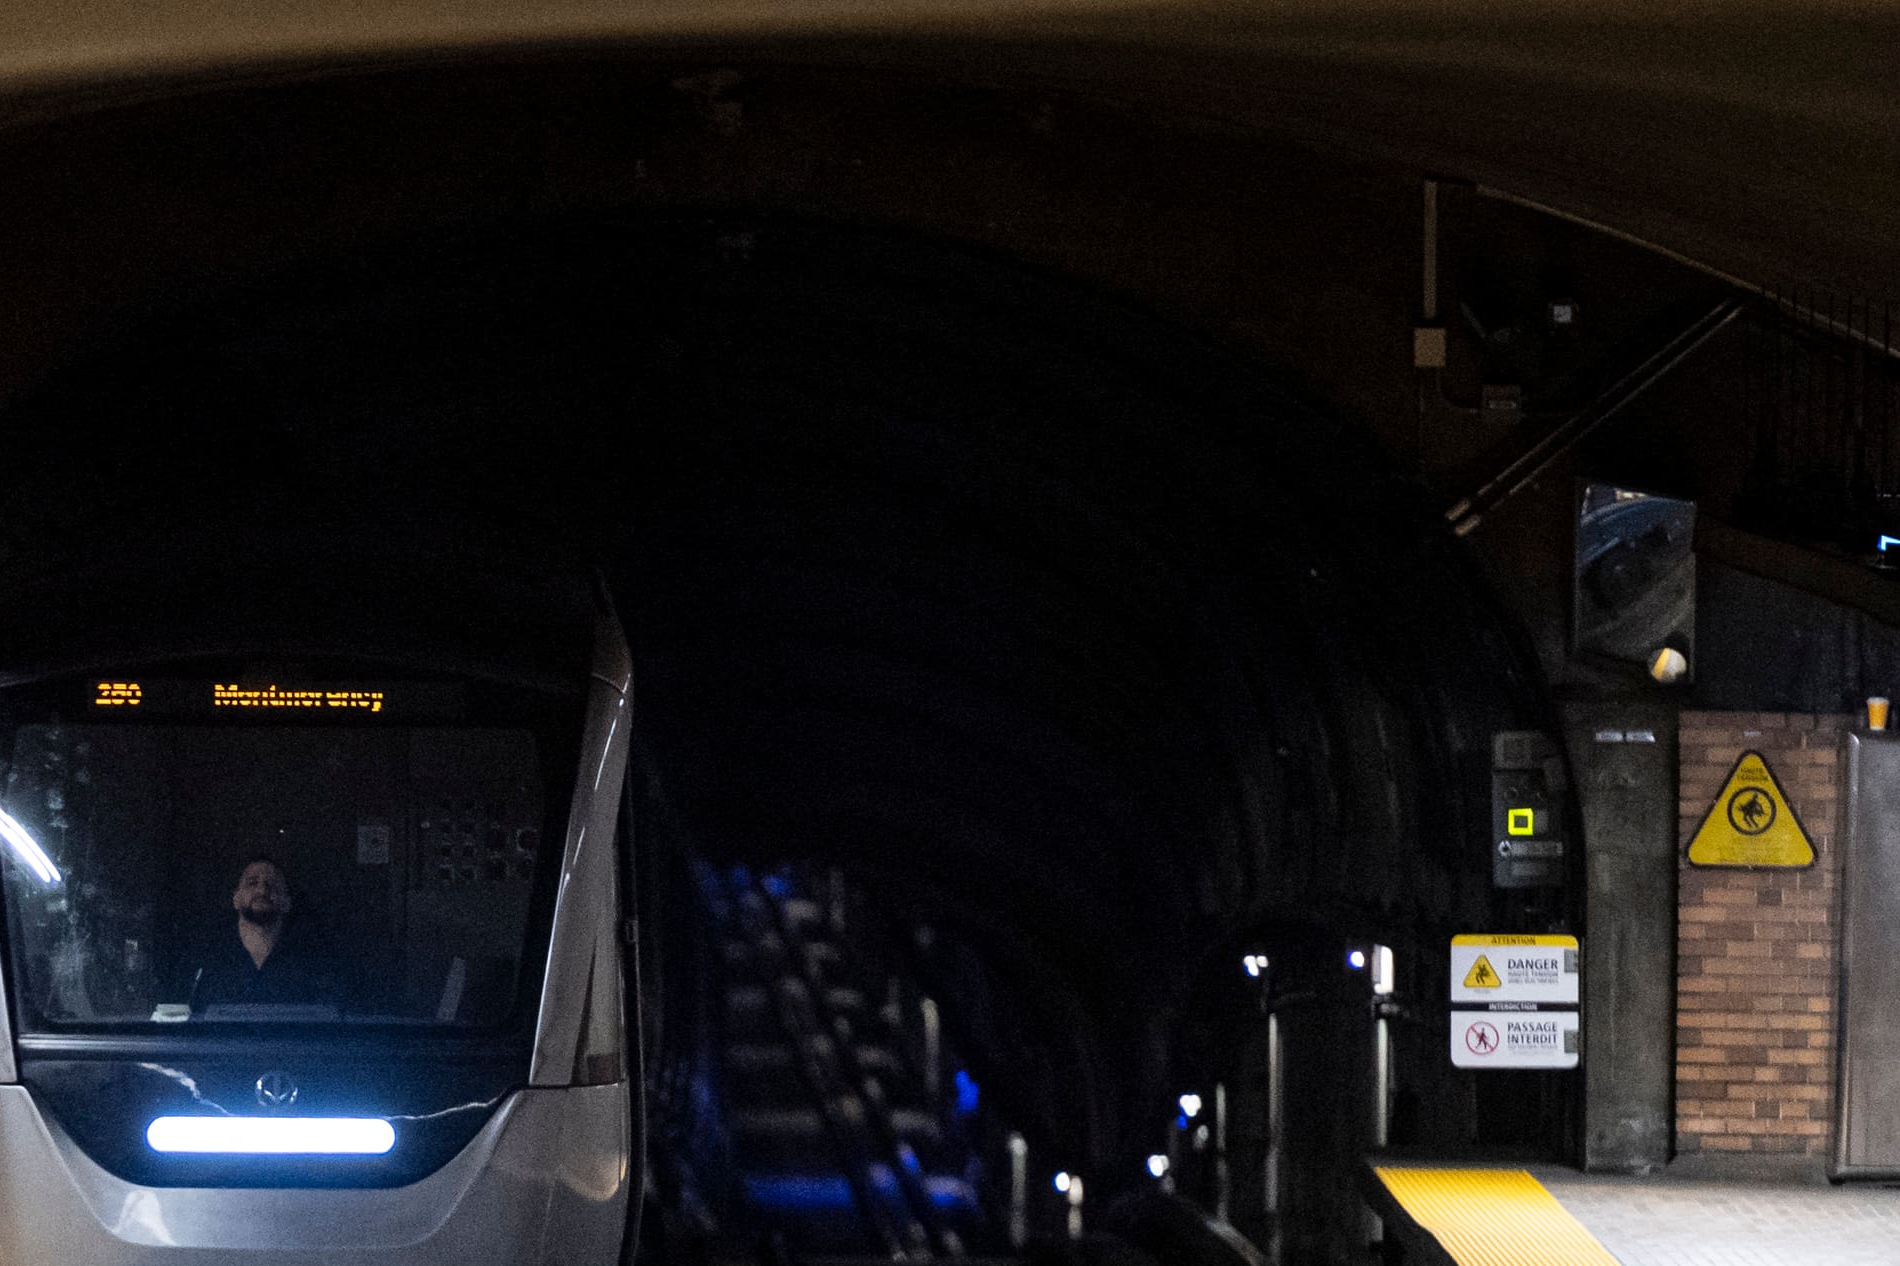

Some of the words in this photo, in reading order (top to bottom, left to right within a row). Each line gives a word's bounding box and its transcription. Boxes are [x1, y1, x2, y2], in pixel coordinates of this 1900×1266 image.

[1491, 935, 1536, 945] ATTENTION
[1507, 958, 1558, 970] DANGER
[1507, 1021, 1557, 1032] PASSAGE
[1507, 1033, 1557, 1044] INTERDIT
